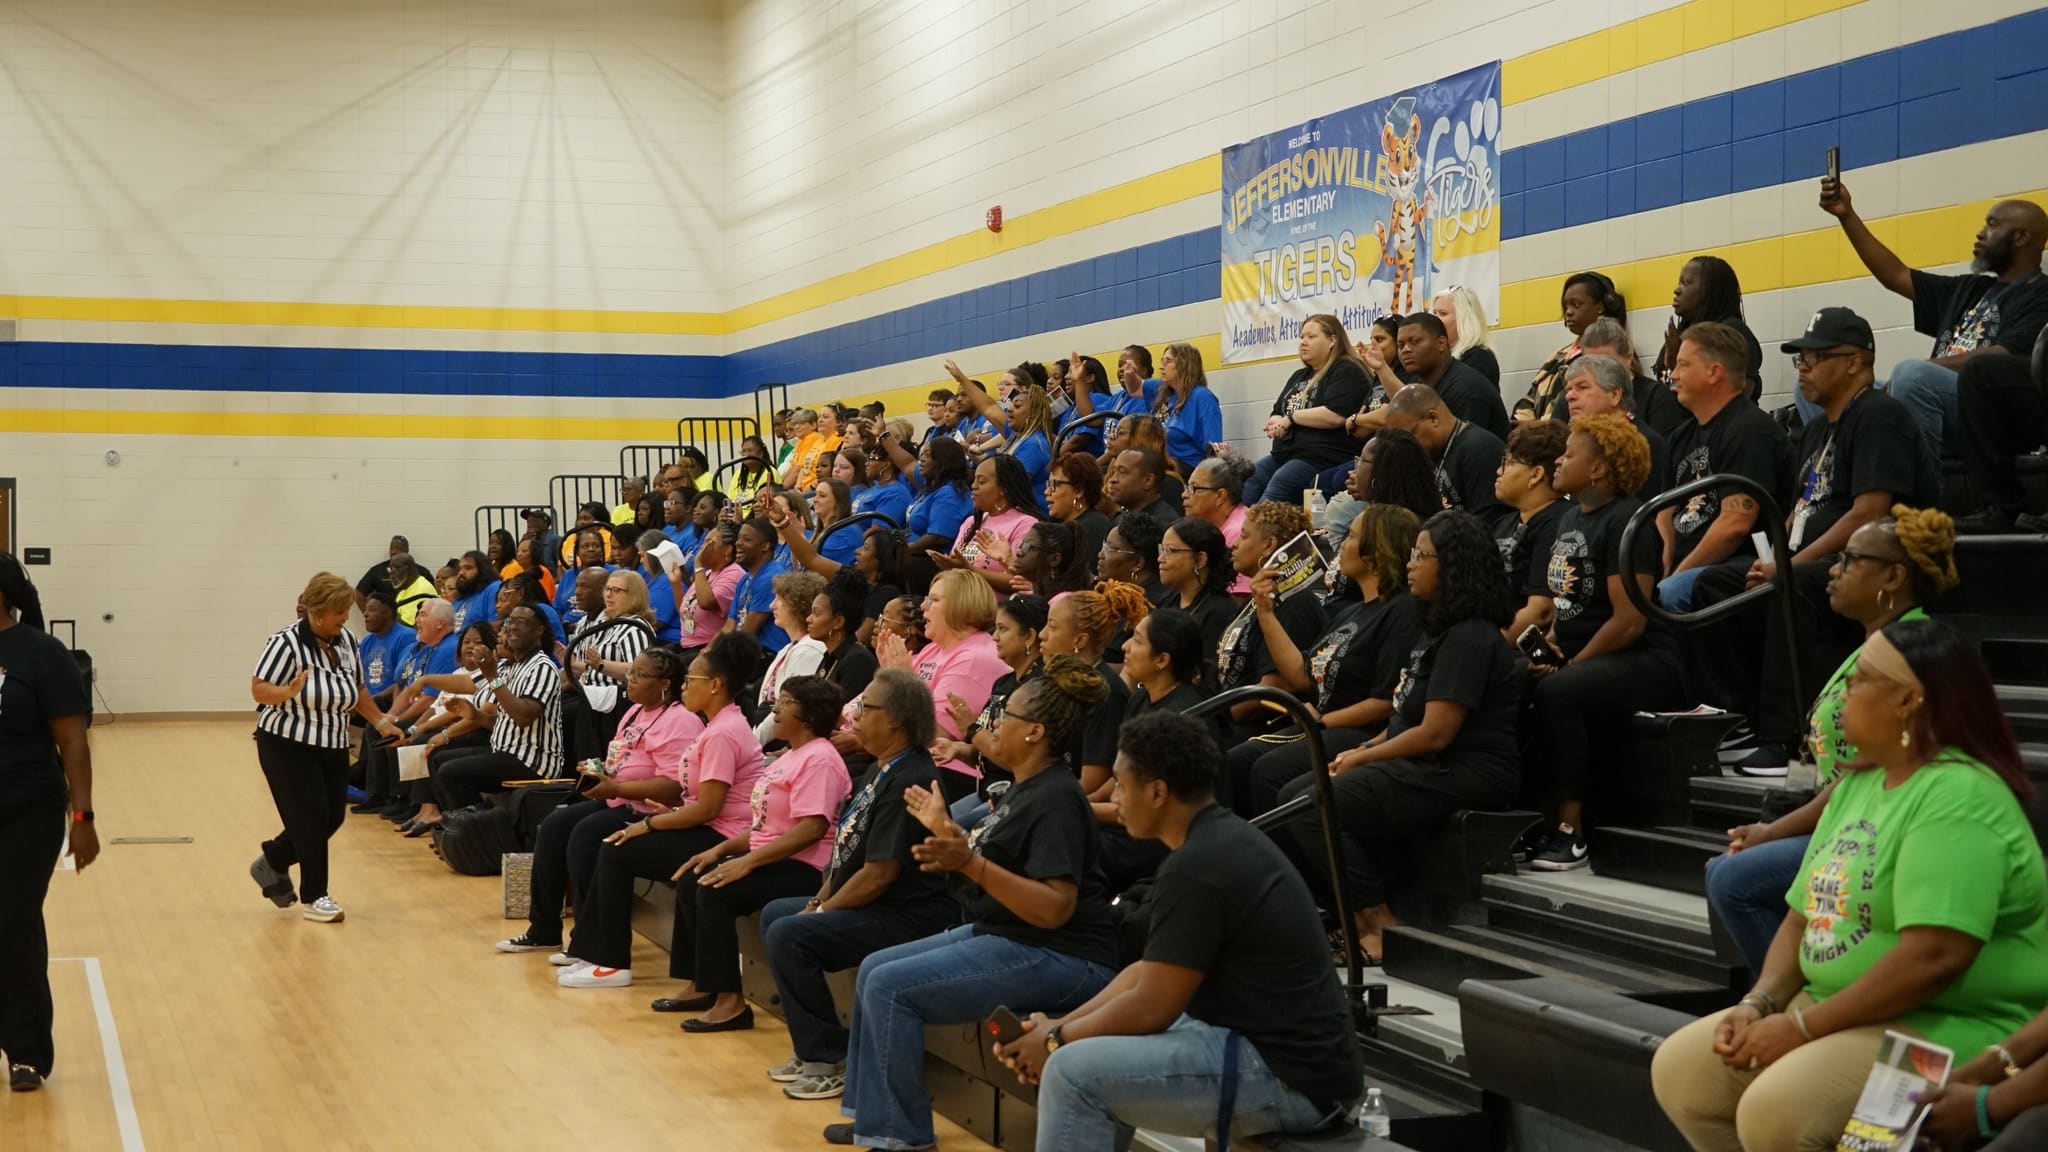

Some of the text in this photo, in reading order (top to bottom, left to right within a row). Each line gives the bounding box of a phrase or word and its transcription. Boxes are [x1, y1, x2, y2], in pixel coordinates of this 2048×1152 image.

[1288, 130, 1321, 150] WELCOME TO
[1226, 146, 1390, 234] JEFFERSONVILLE
[1272, 190, 1336, 225] ELEMENTARY
[1426, 162, 1494, 248] Tigers
[1254, 231, 1356, 307] TIGERS
[1233, 321, 1277, 348] Academics,
[1807, 313, 1822, 332] T
[1811, 876, 1841, 897] GAME
[1813, 942, 1848, 964] HIGH
